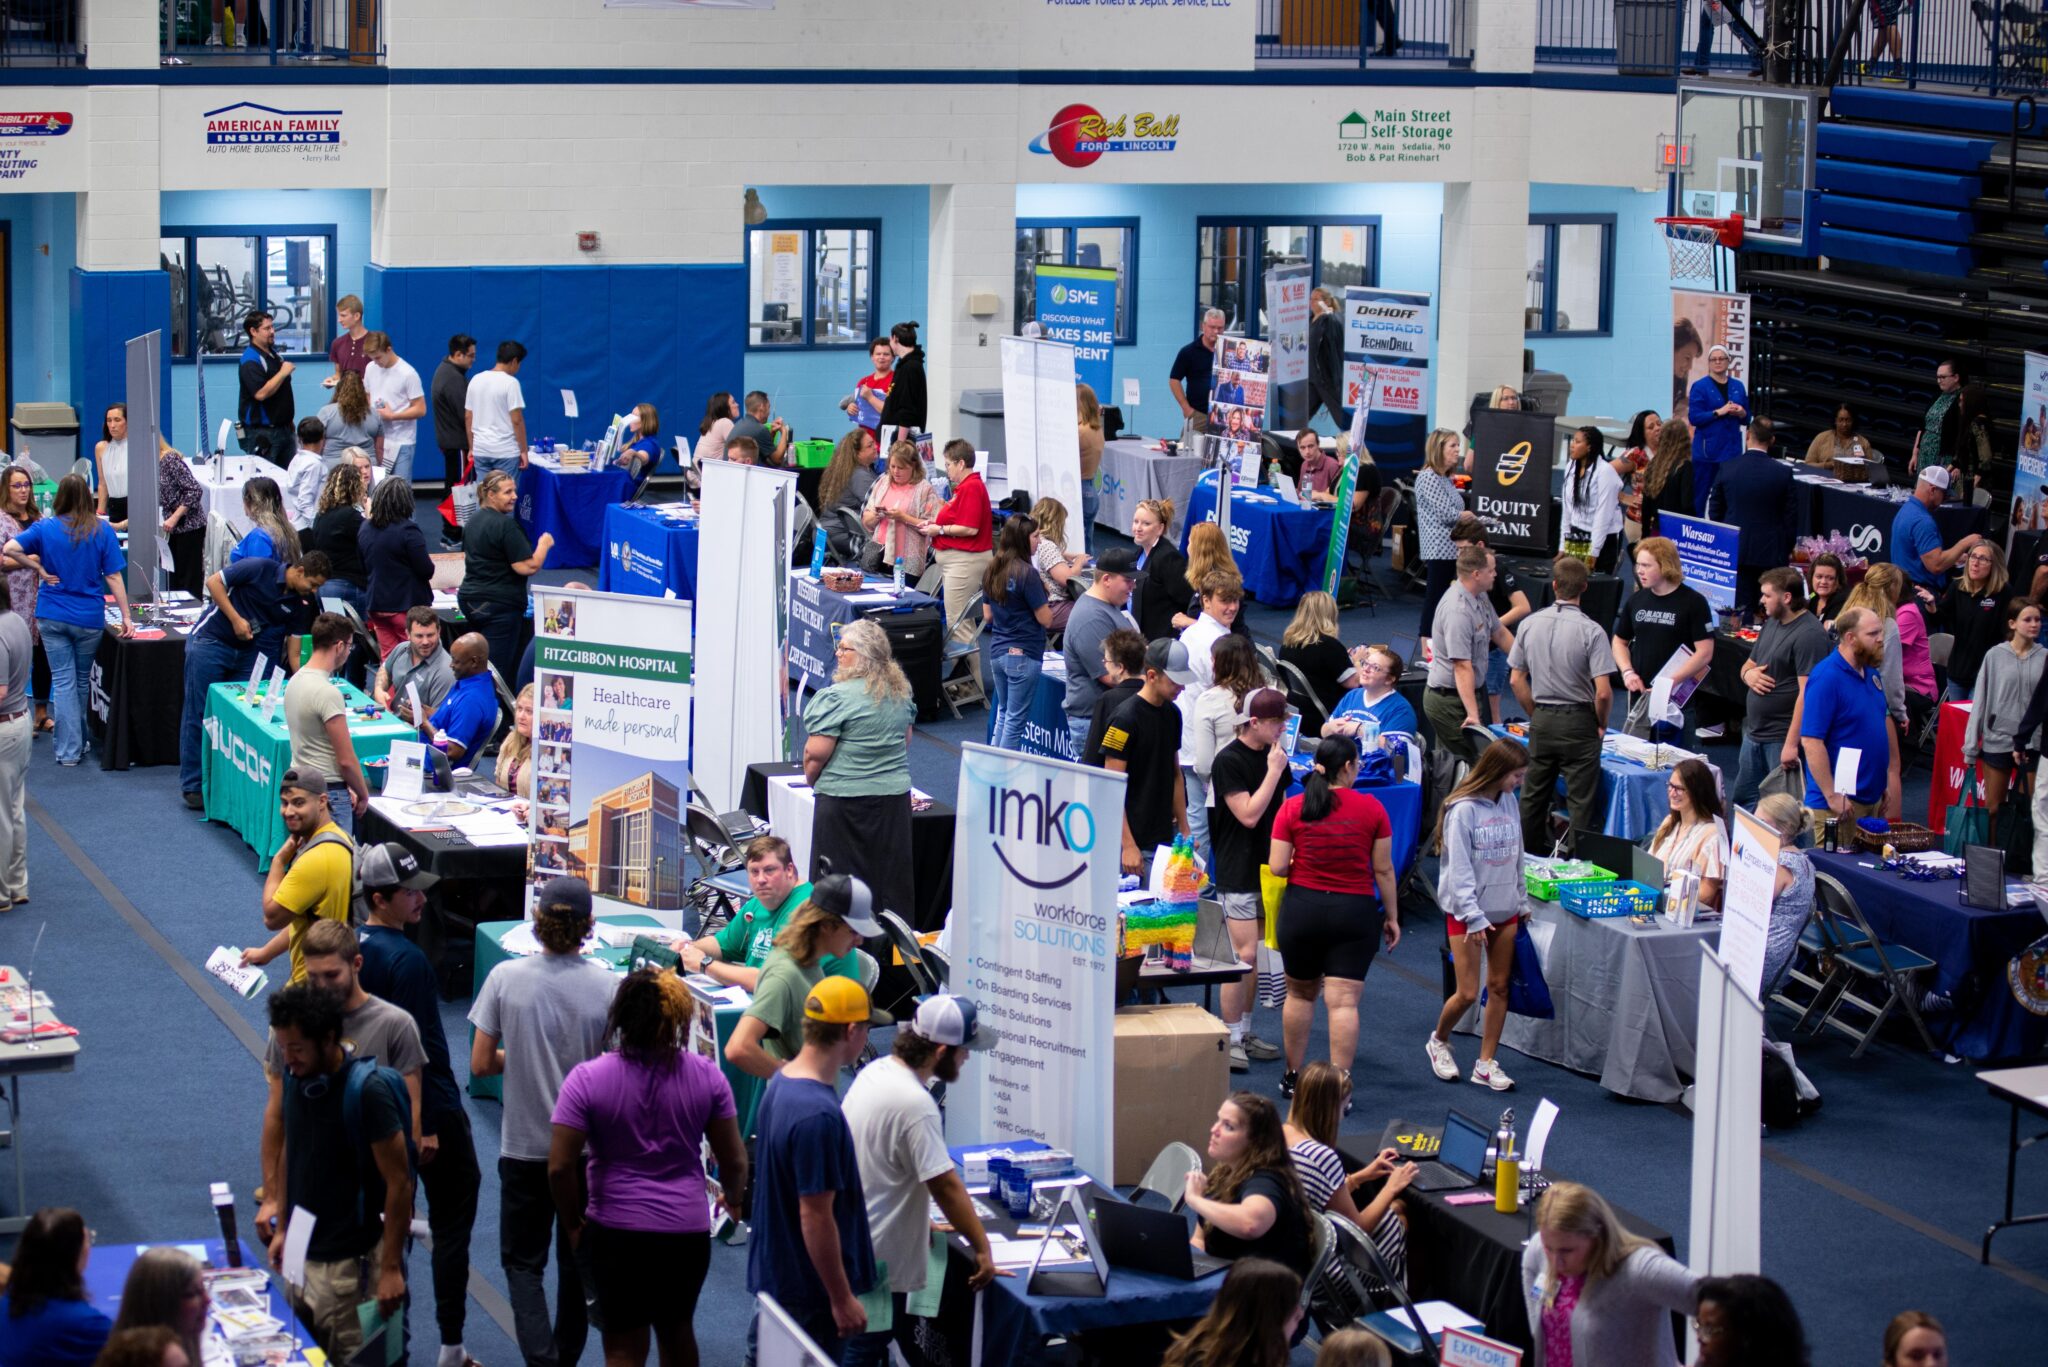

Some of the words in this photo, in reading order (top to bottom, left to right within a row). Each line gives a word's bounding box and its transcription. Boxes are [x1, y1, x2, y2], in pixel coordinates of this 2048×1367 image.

[1374, 109, 1406, 122] Main
[1411, 109, 1451, 122] Street
[207, 120, 283, 132] AMERICAN
[288, 119, 340, 131] FAMILY
[1078, 114, 1127, 139] Rick
[1133, 112, 1180, 138] Ball
[1371, 125, 1453, 141] Self-Storage
[217, 133, 330, 142] INSURANCE
[1081, 142, 1111, 151] FORD
[1122, 141, 1170, 151] LINCOLN
[207, 145, 227, 154] AUTO
[229, 144, 252, 153] HOME
[254, 144, 291, 153] BUSINESS
[293, 144, 322, 153] HEALTH
[324, 144, 340, 153] LIFE
[1338, 143, 1358, 151] 1720
[1374, 143, 1395, 151] Main
[1402, 143, 1435, 152] Sedalia,
[1438, 143, 1451, 151] MO
[1346, 153, 1366, 162] Bob
[1369, 153, 1376, 162] &
[1379, 153, 1395, 162] Pat
[1398, 153, 1440, 162] Rinehart
[1068, 289, 1098, 305] SME
[1041, 313, 1081, 324] DISCOVER
[1082, 316, 1106, 326] WHAT
[1356, 305, 1419, 319] DeHOFF
[1047, 327, 1081, 342] AKES
[1083, 330, 1112, 344] SME
[1351, 319, 1424, 334] ELDORADO
[1727, 299, 1745, 378] ESENCE
[1074, 346, 1109, 361] RENT
[1383, 385, 1419, 399] KAYS
[1477, 496, 1541, 517] EQUITY
[1682, 524, 1715, 544] Warsaw
[797, 580, 821, 607] MISSOURI
[792, 600, 824, 632] DEPARTMENT
[1646, 610, 1662, 619] BLACK
[1663, 612, 1676, 620] RIFLE
[803, 629, 812, 648] OF
[543, 647, 616, 667] FITZGIBBON
[619, 655, 678, 674] HOSPITAL
[788, 645, 825, 679] CORRECTIONS
[593, 687, 671, 710] Healthcare
[584, 708, 619, 732] made
[623, 713, 680, 746] personal
[1021, 720, 1052, 750] stern
[1034, 902, 1106, 932] workforce
[1014, 920, 1106, 957] SOLUTIONS
[976, 957, 1023, 978] Contingent
[1025, 969, 1062, 989] Staffing
[1072, 956, 1088, 967] EST.
[1089, 961, 1106, 972] 1972
[975, 978, 989, 991] On
[991, 982, 1029, 1004] Boarding
[1031, 992, 1072, 1011] Services
[975, 1000, 1007, 1018] On-Site
[1008, 1009, 1052, 1029] Solutions
[1029, 1035, 1086, 1058] Recruitment
[989, 1049, 1044, 1070] Engagement
[989, 1074, 1019, 1090] Members
[1015, 1125, 1046, 1140] Certified
[1453, 1338, 1508, 1367] EXPLORE
